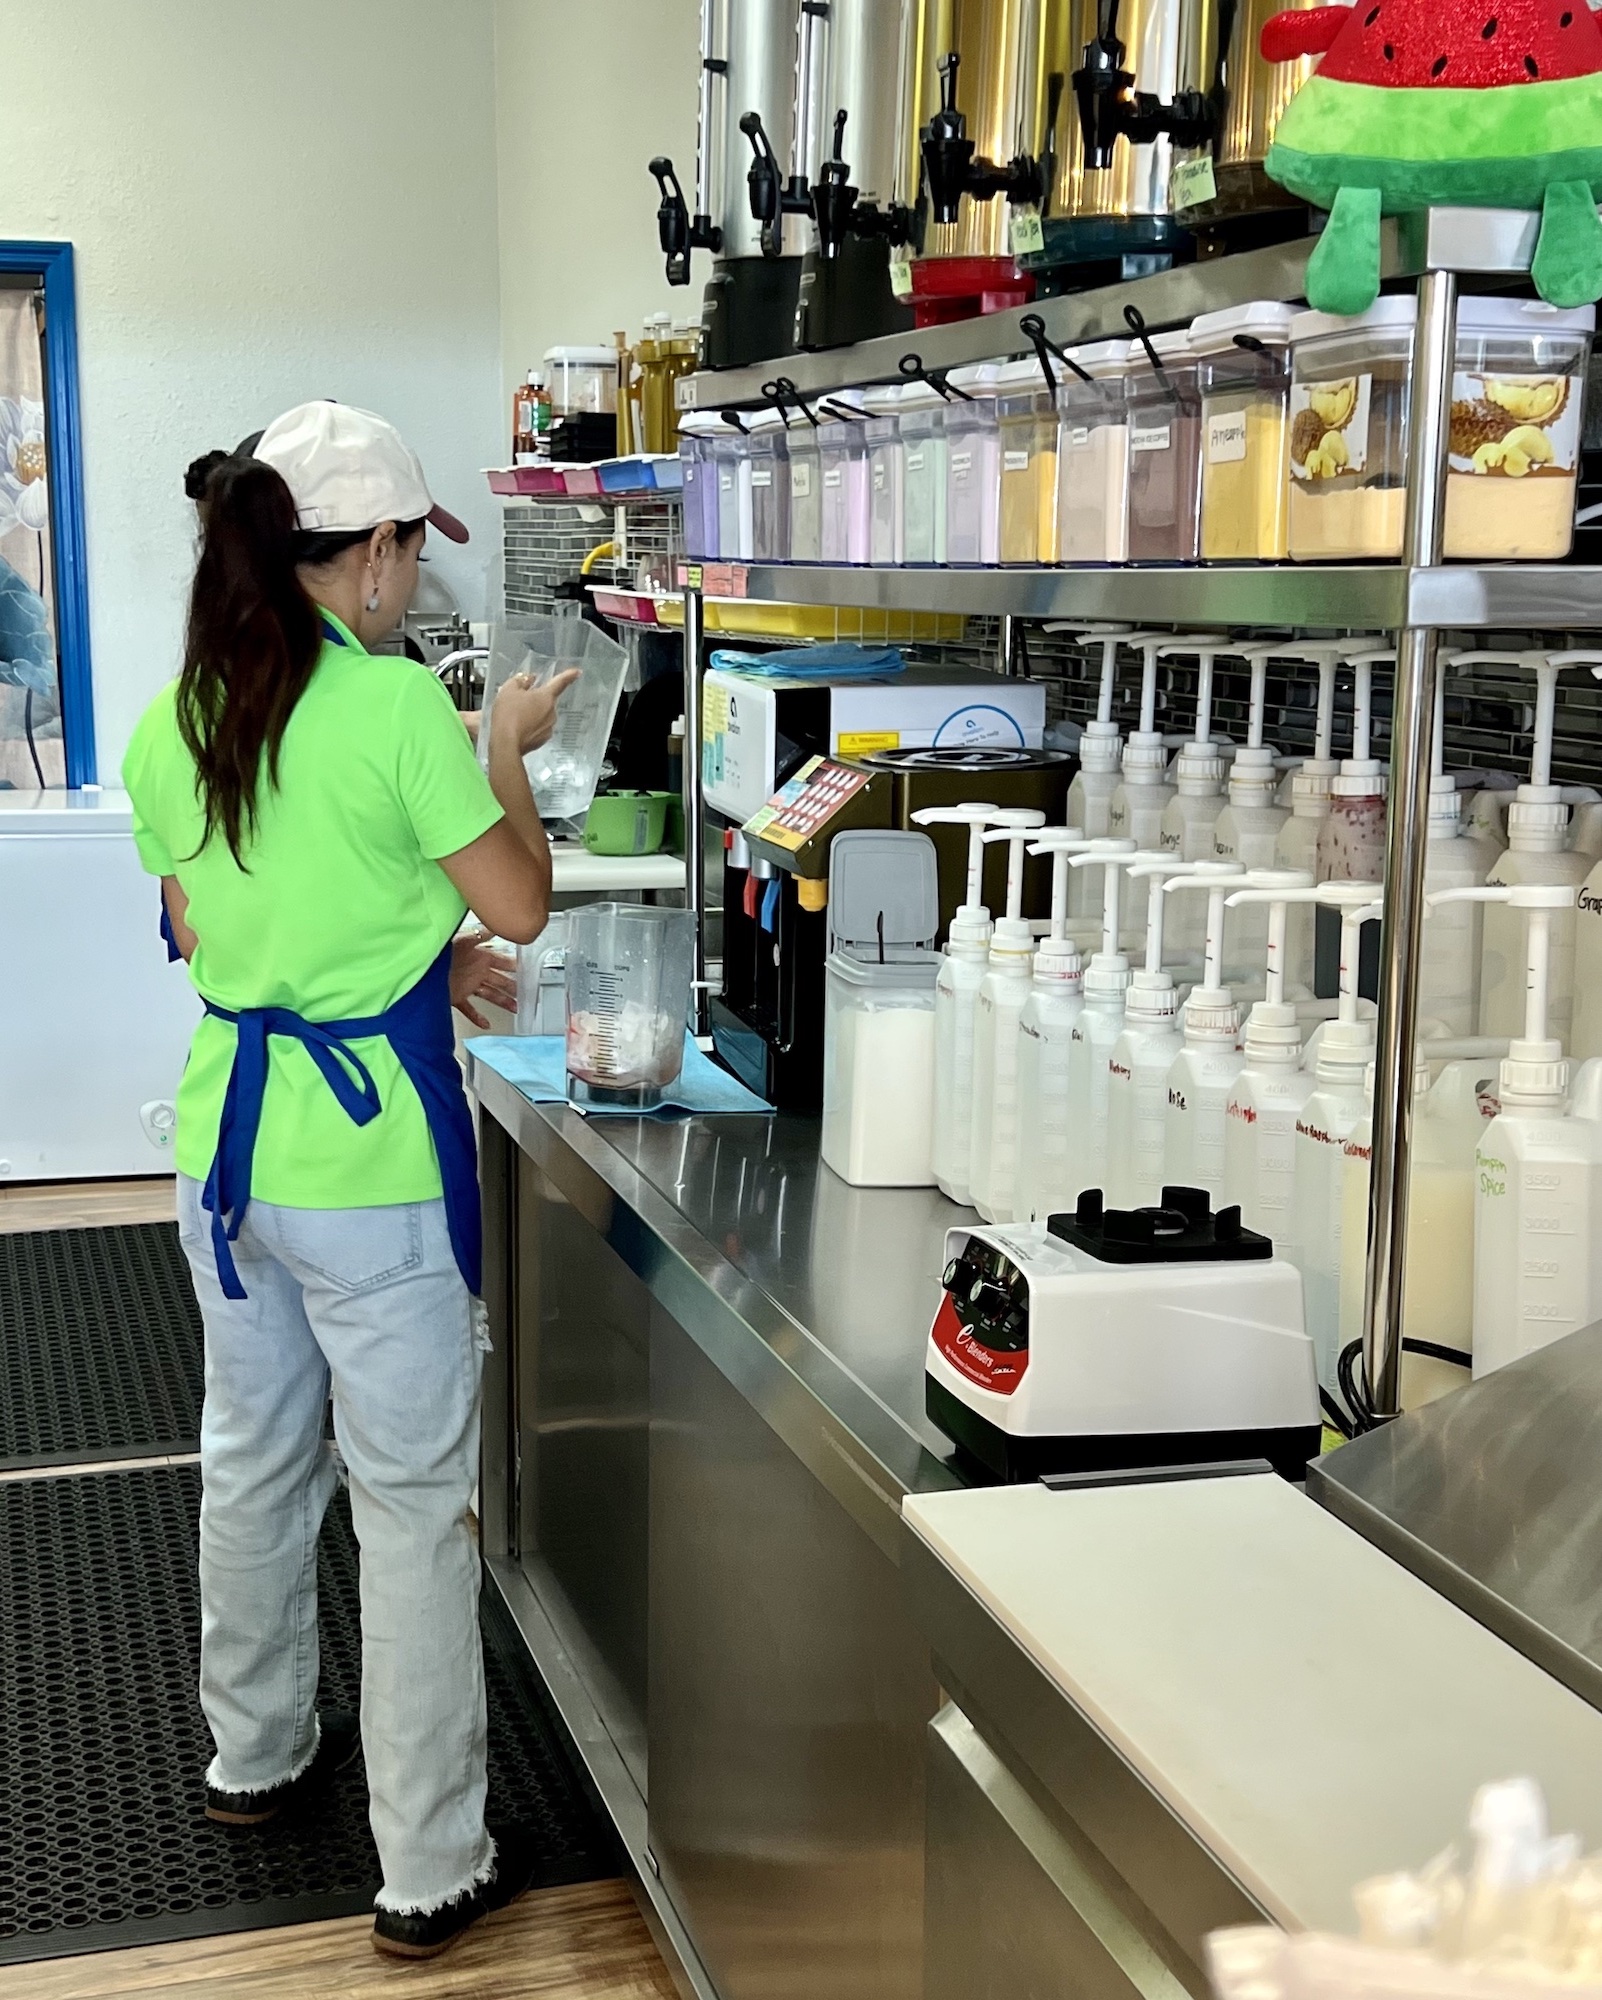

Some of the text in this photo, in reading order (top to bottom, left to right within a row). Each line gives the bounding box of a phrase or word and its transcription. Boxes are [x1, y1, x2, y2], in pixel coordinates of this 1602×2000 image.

[859, 736, 888, 744] WARNING
[1480, 1173, 1506, 1198] Spice
[1524, 1174, 1561, 1186] 3500
[967, 1341, 994, 1368] Blenders
